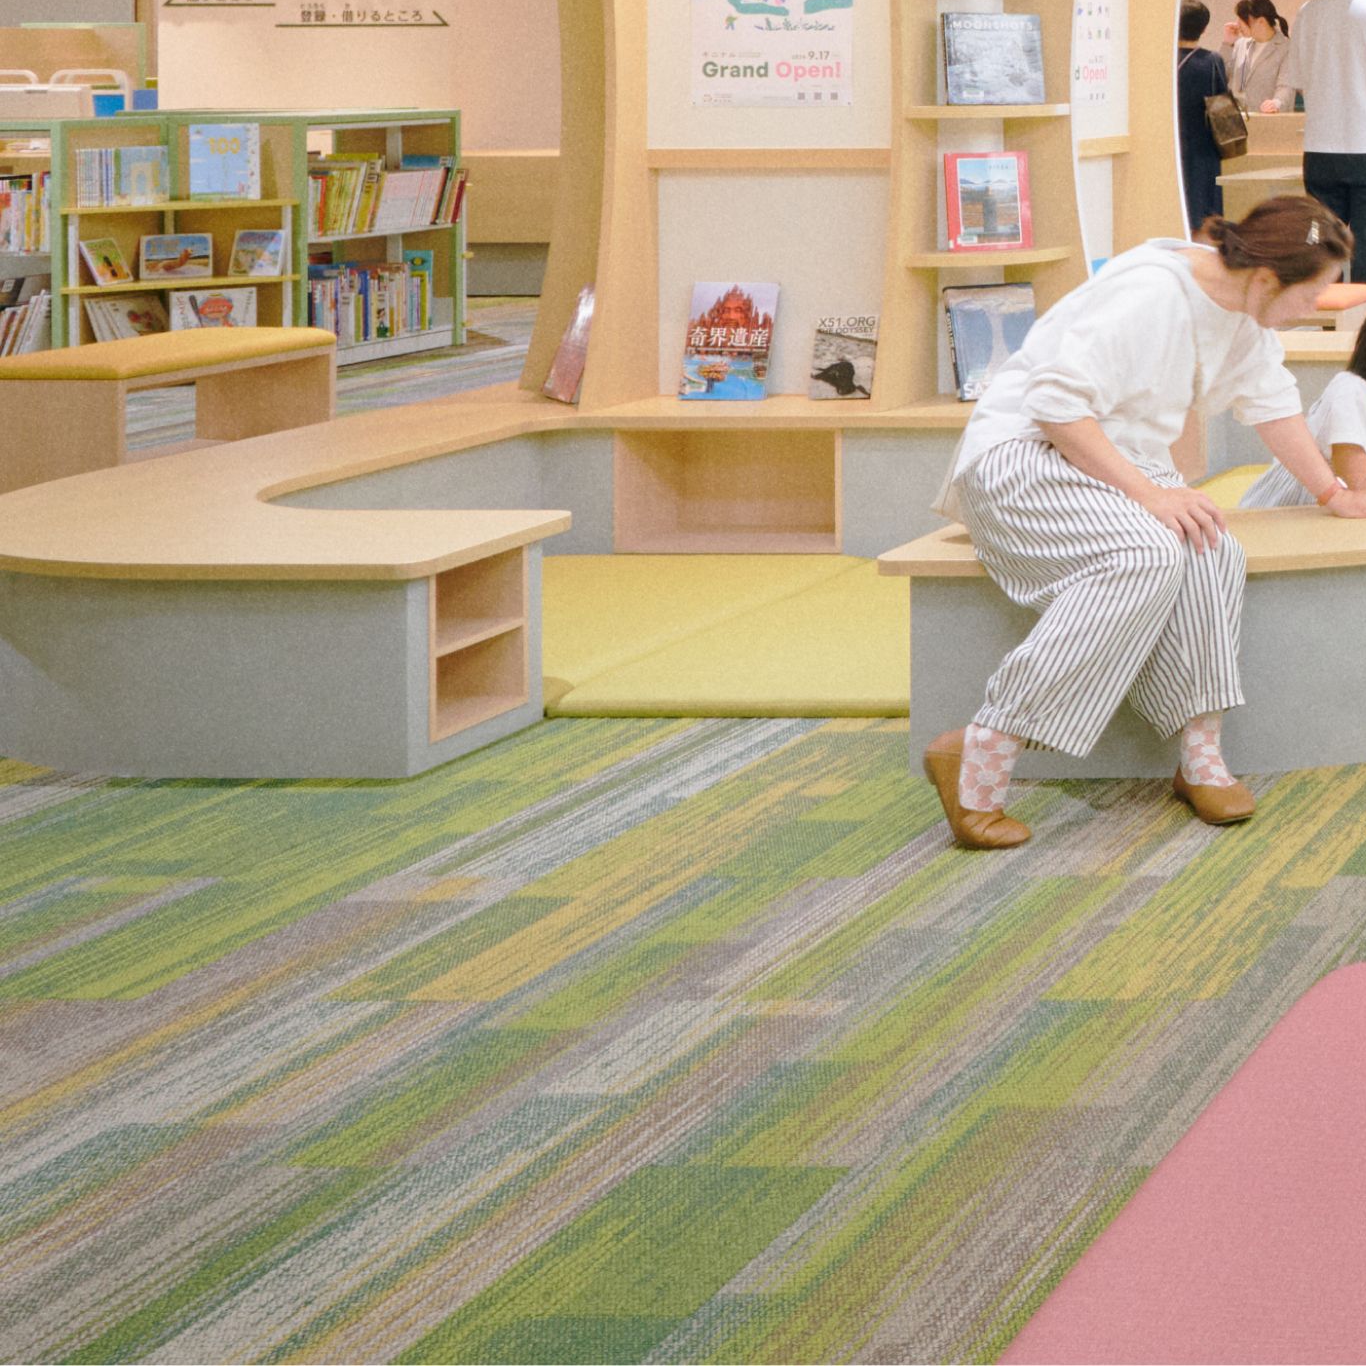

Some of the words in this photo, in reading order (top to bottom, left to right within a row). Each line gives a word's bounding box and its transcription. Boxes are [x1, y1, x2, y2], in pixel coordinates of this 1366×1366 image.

[808, 50, 830, 61] 9.17
[702, 61, 769, 78] Grand
[775, 61, 842, 83] Open!
[208, 137, 241, 155] 100
[818, 316, 876, 328] X51.ORG
[690, 326, 769, 347] 奇界遺産
